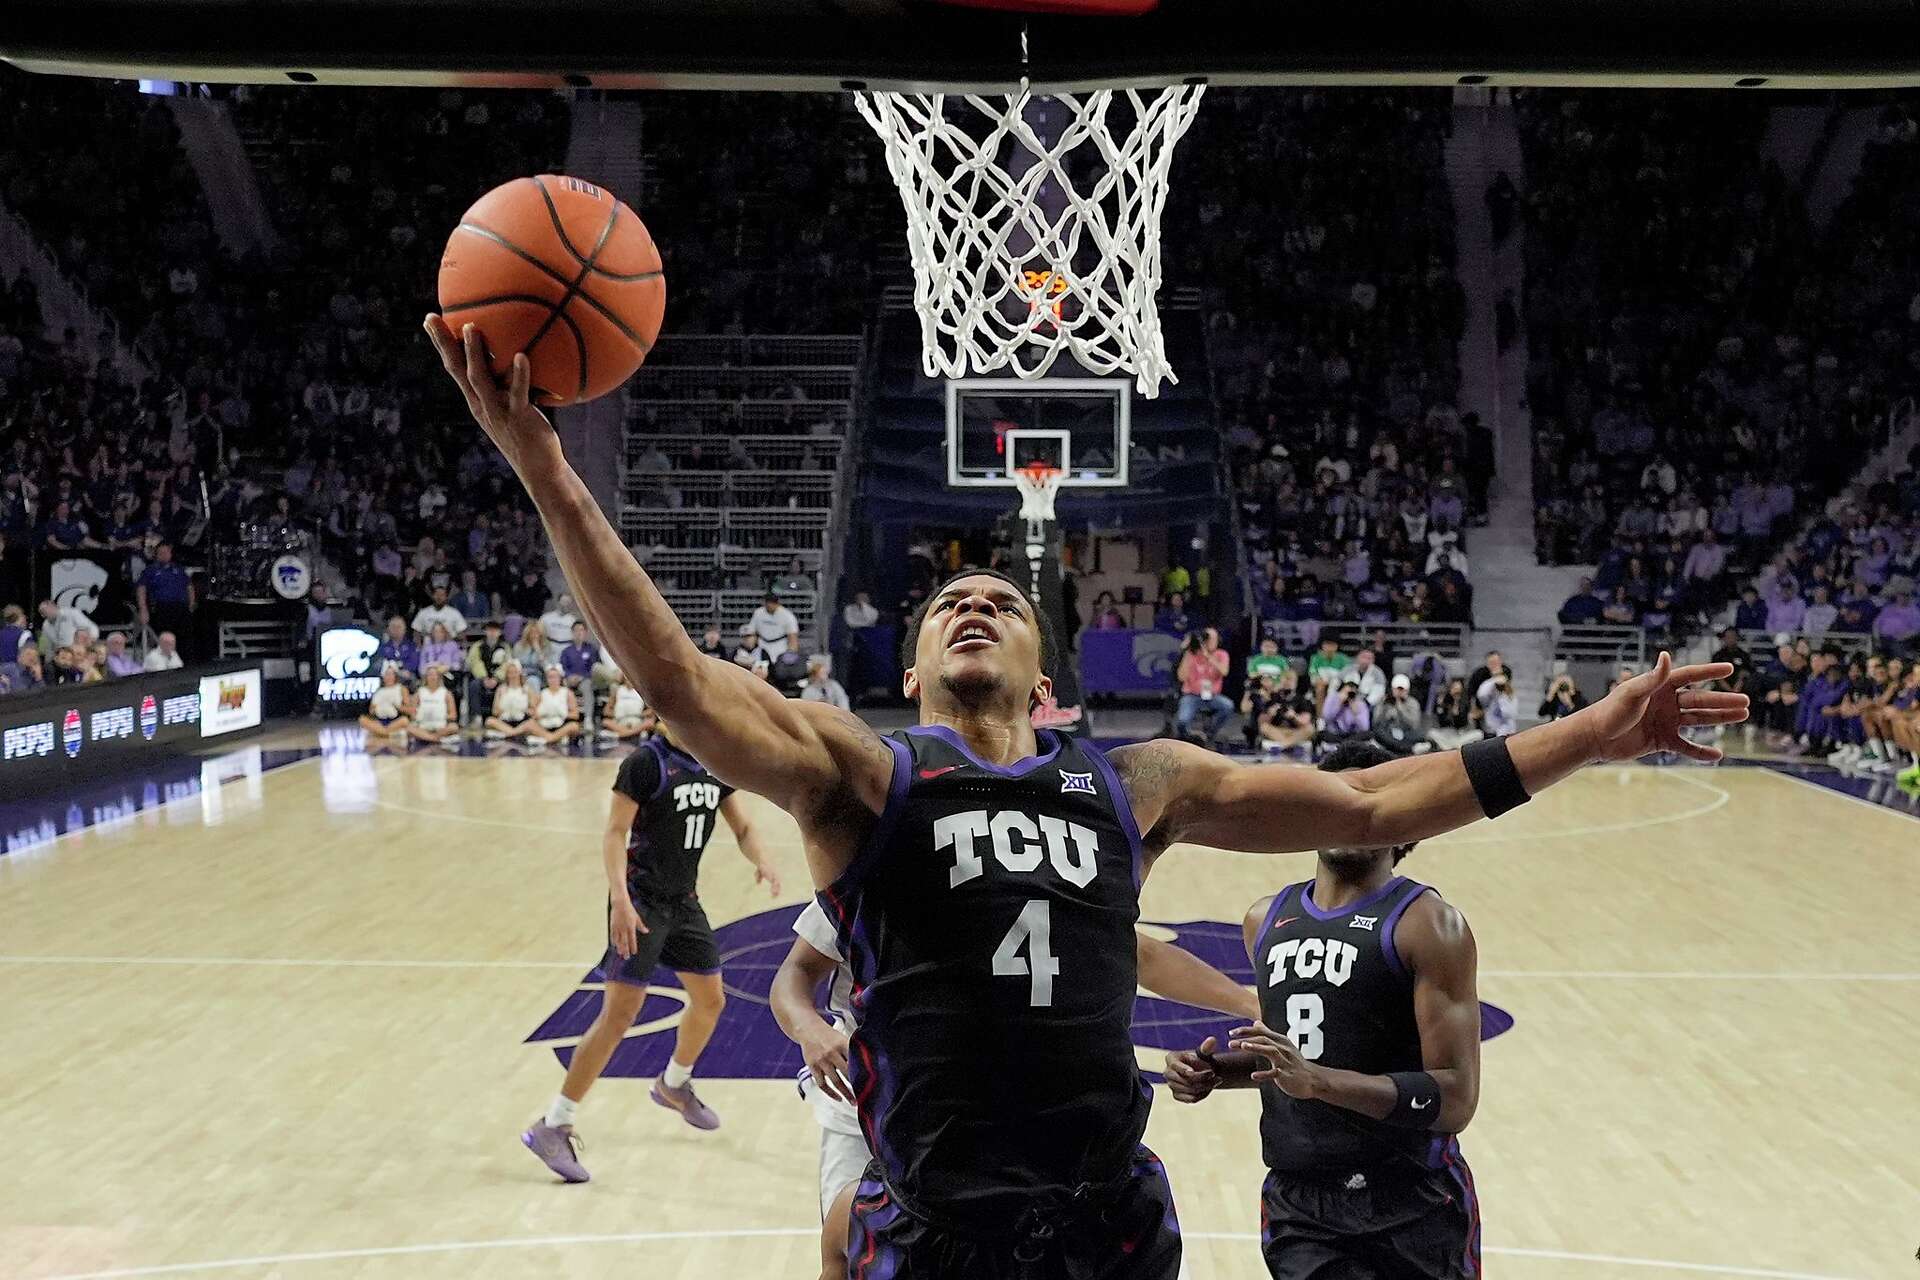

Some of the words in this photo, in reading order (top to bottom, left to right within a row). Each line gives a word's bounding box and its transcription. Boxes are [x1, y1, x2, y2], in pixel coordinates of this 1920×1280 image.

[4, 722, 54, 759] PEPSI
[91, 706, 134, 740] PEPSI
[674, 782, 720, 812] TCU
[684, 814, 706, 849] 11
[933, 810, 1099, 889] TCU
[992, 900, 1059, 1006] 4
[1266, 938, 1359, 988] TCU
[1286, 993, 1325, 1060] 8
